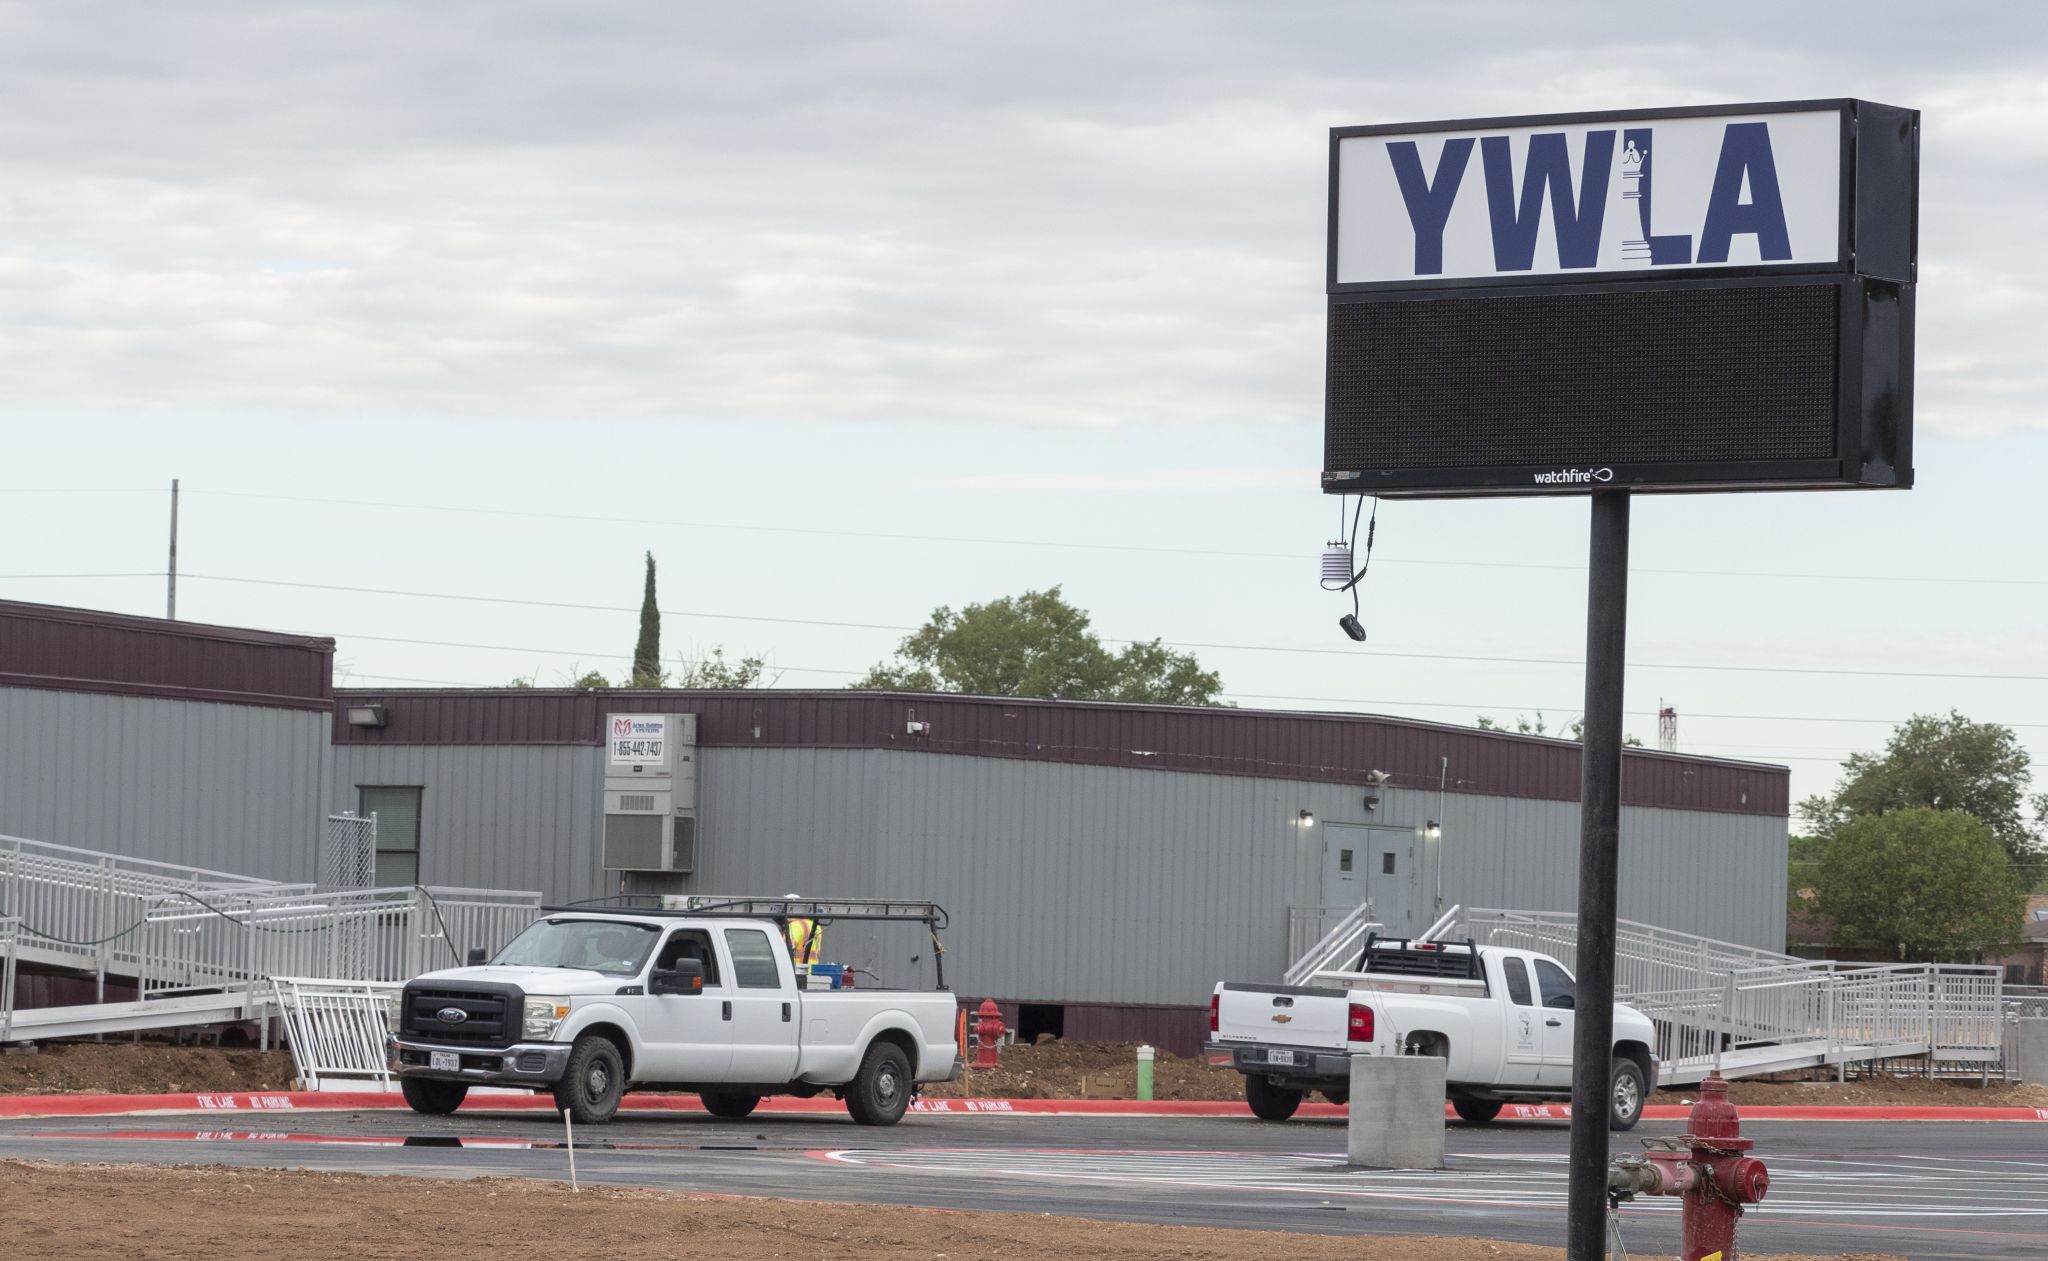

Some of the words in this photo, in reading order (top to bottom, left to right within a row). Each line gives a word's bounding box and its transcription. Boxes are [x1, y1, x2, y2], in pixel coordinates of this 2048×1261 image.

[1385, 122, 1792, 275] YWLA
[1534, 468, 1591, 483] watchfire
[215, 1096, 238, 1108] LANE
[249, 1096, 262, 1108] NO
[261, 1096, 293, 1108] PARKING
[928, 1101, 951, 1111] LANE
[965, 1101, 978, 1111] NO
[978, 1101, 1012, 1111] PARKING
